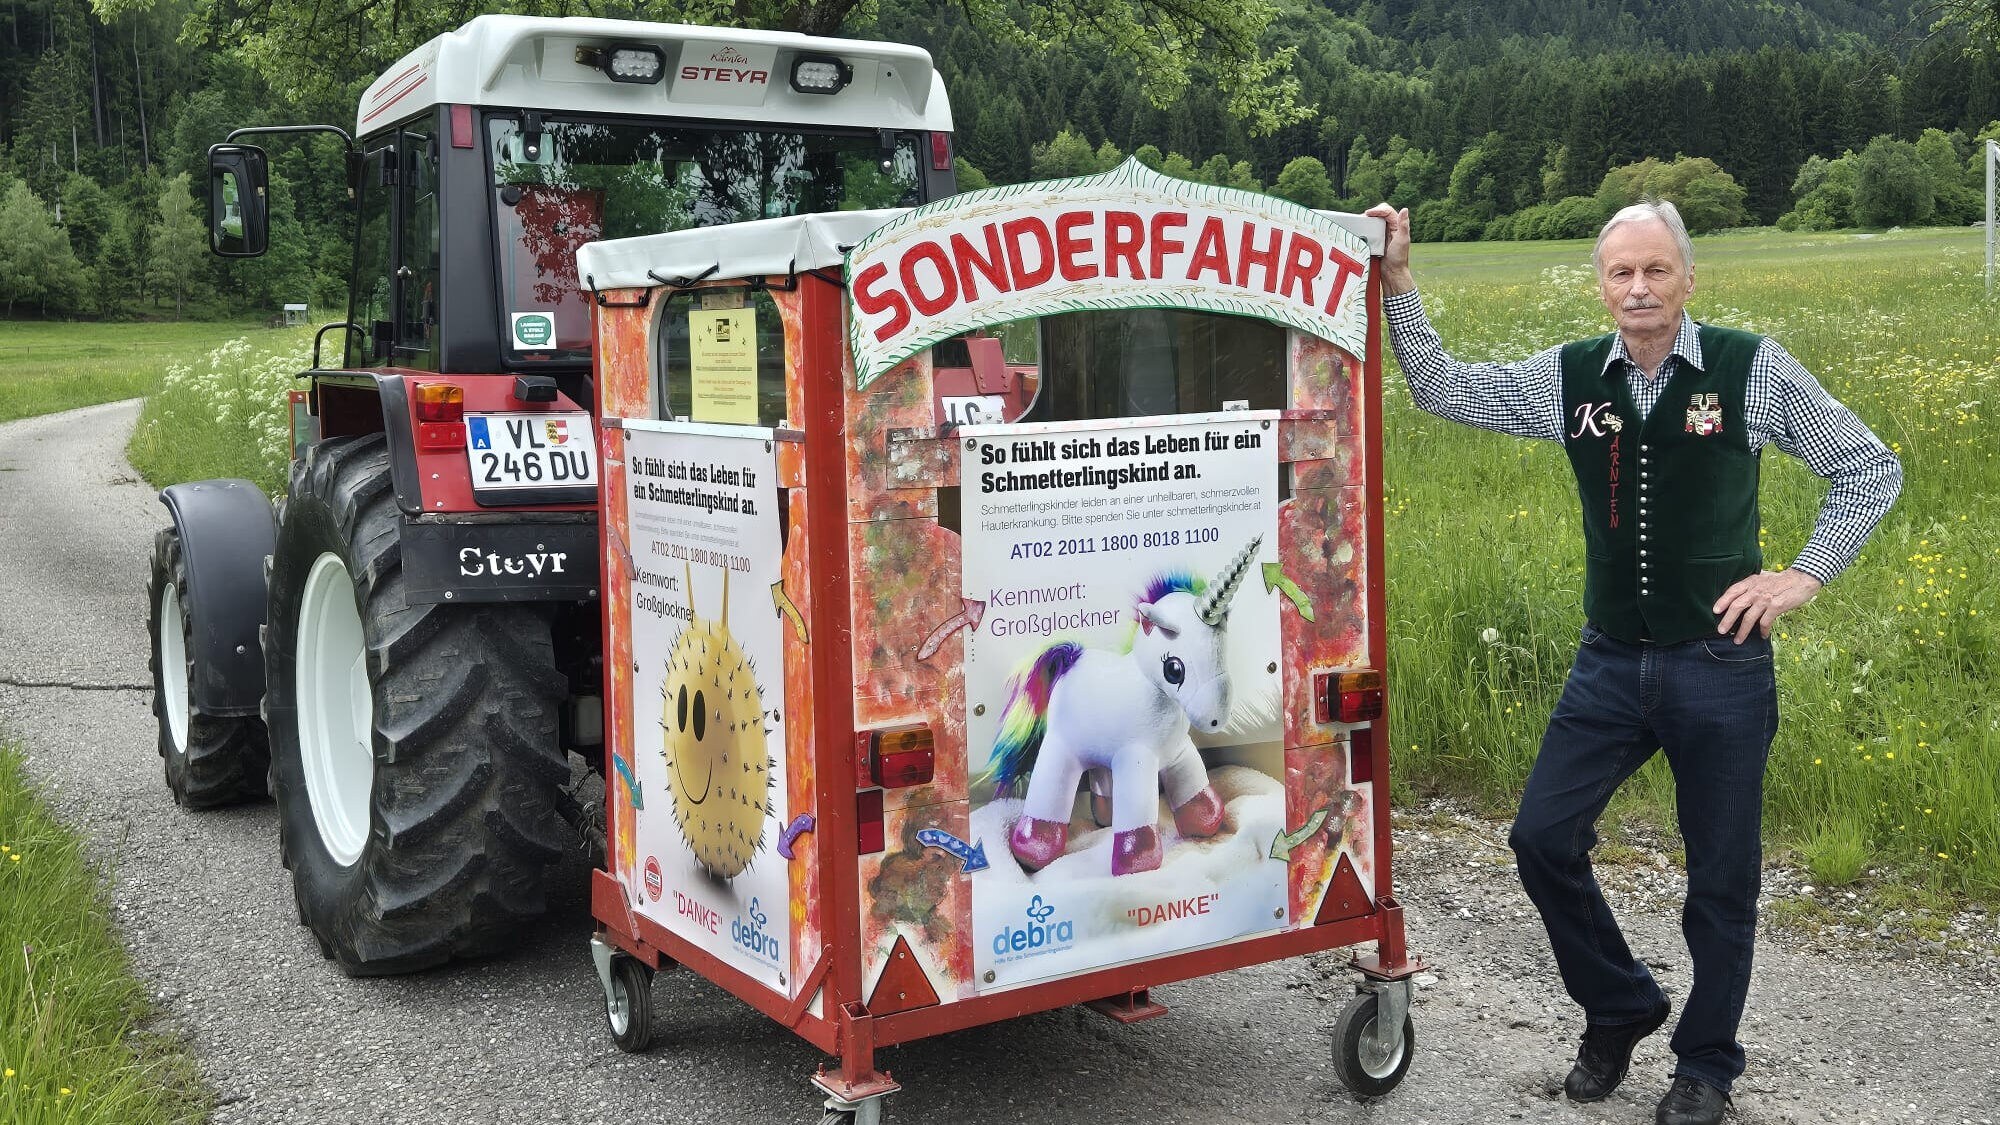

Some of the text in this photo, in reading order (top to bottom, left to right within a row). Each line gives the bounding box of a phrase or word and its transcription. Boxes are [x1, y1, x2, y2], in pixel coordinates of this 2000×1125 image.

[681, 66, 768, 84] STEYR
[853, 210, 1365, 343] SONDERFAHRT
[477, 419, 546, 449] A VL
[1570, 401, 1612, 439] K
[981, 429, 1261, 465] So fühlt sich das Leben für ein
[481, 451, 590, 482] 246 DU
[632, 456, 756, 488] So fühlt sich das Leben für
[981, 462, 1201, 493] Schmetterlingskind an.
[634, 481, 758, 516] ein Schmetterlingskind an.
[981, 486, 1260, 515] Schmetterlingskinder leiden an einer unheilbaren, schmerzvollen
[981, 501, 1261, 531] Hauterkrankung. Bitte spenden Sie unter schmetterlingskinder.at
[651, 540, 751, 573] AT02 2011 1800 8018 1100
[1010, 527, 1220, 560] AT02 2011 1800 8018 1100
[459, 547, 567, 579] Steyr
[636, 567, 679, 592] Kennwort:
[990, 582, 1087, 608] Kennwort:
[636, 592, 695, 623] Großglockner
[990, 608, 1120, 637] Großglockner
[673, 890, 723, 935] "DANKE"
[1127, 893, 1220, 927] "DANKE"
[731, 915, 780, 961] debra
[992, 919, 1074, 955] debra
